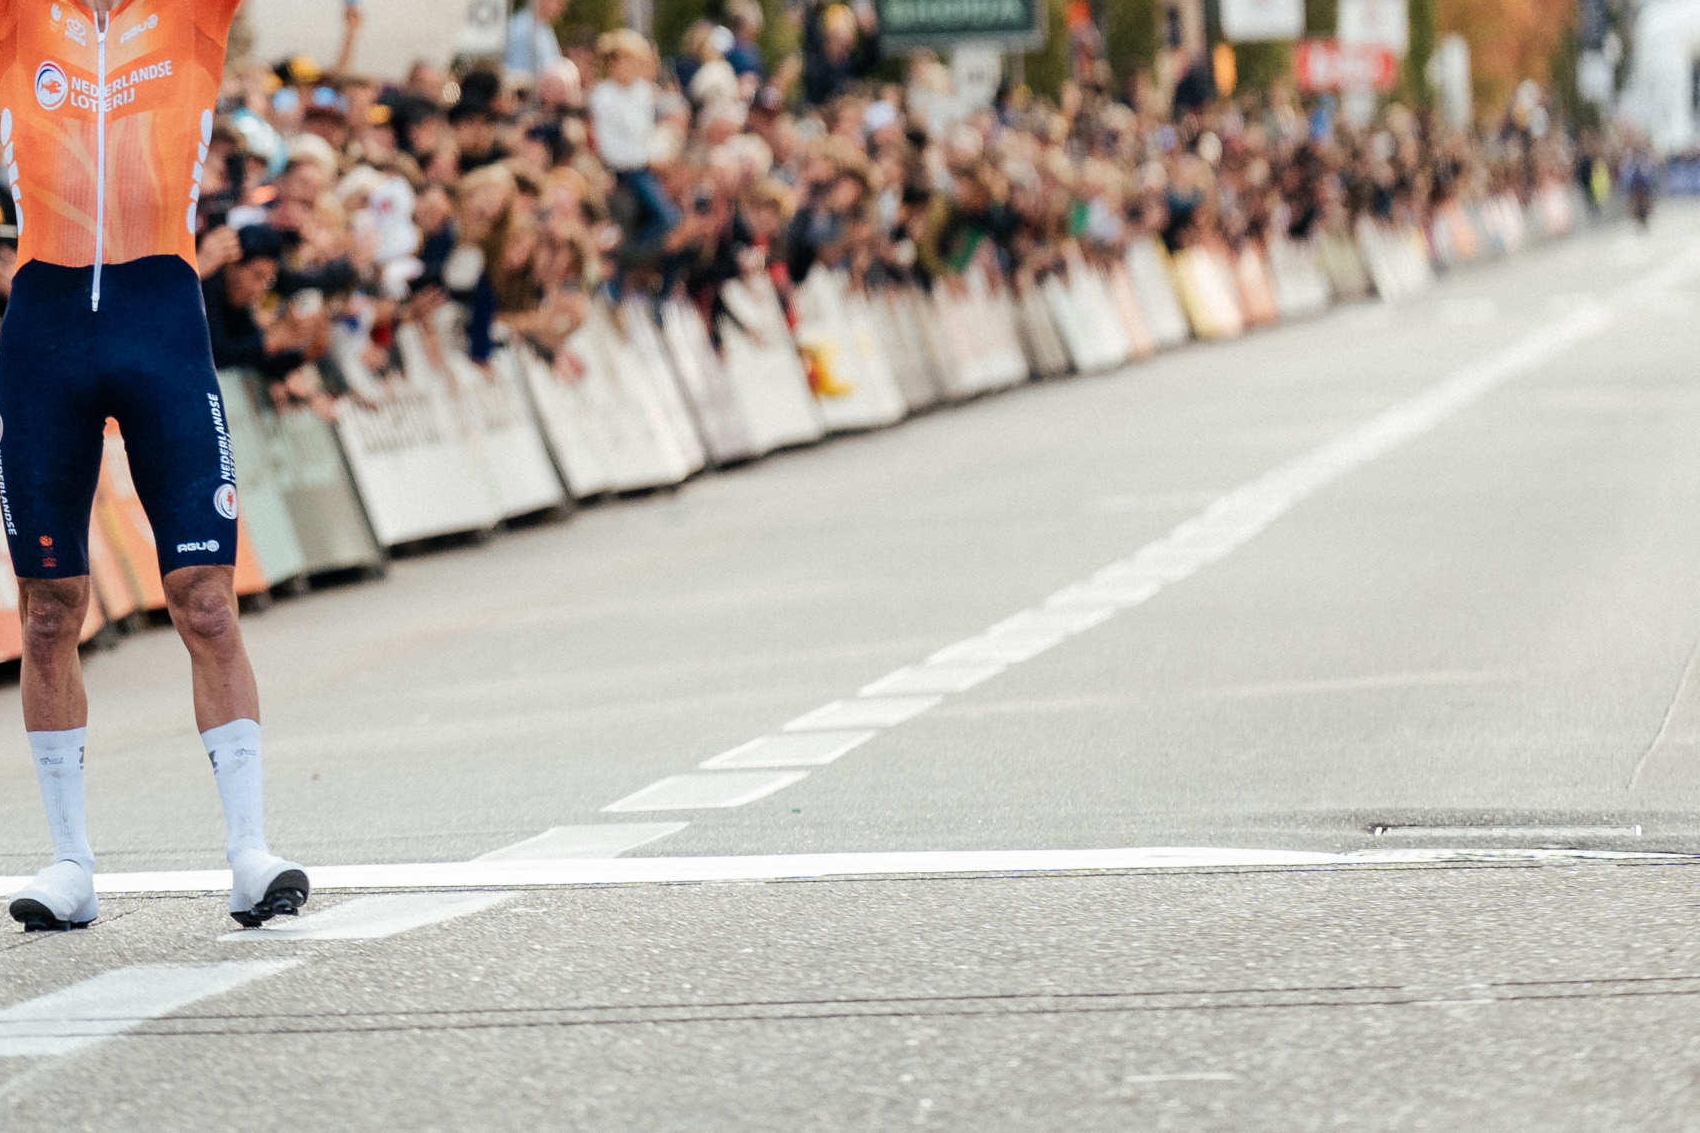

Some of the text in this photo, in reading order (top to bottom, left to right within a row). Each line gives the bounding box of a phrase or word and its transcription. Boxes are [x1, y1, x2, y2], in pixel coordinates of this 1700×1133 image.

[71, 60, 173, 98] NEDERLANDSE
[70, 87, 136, 113] LOTERIJ
[207, 392, 231, 481] NEDERLANDSE
